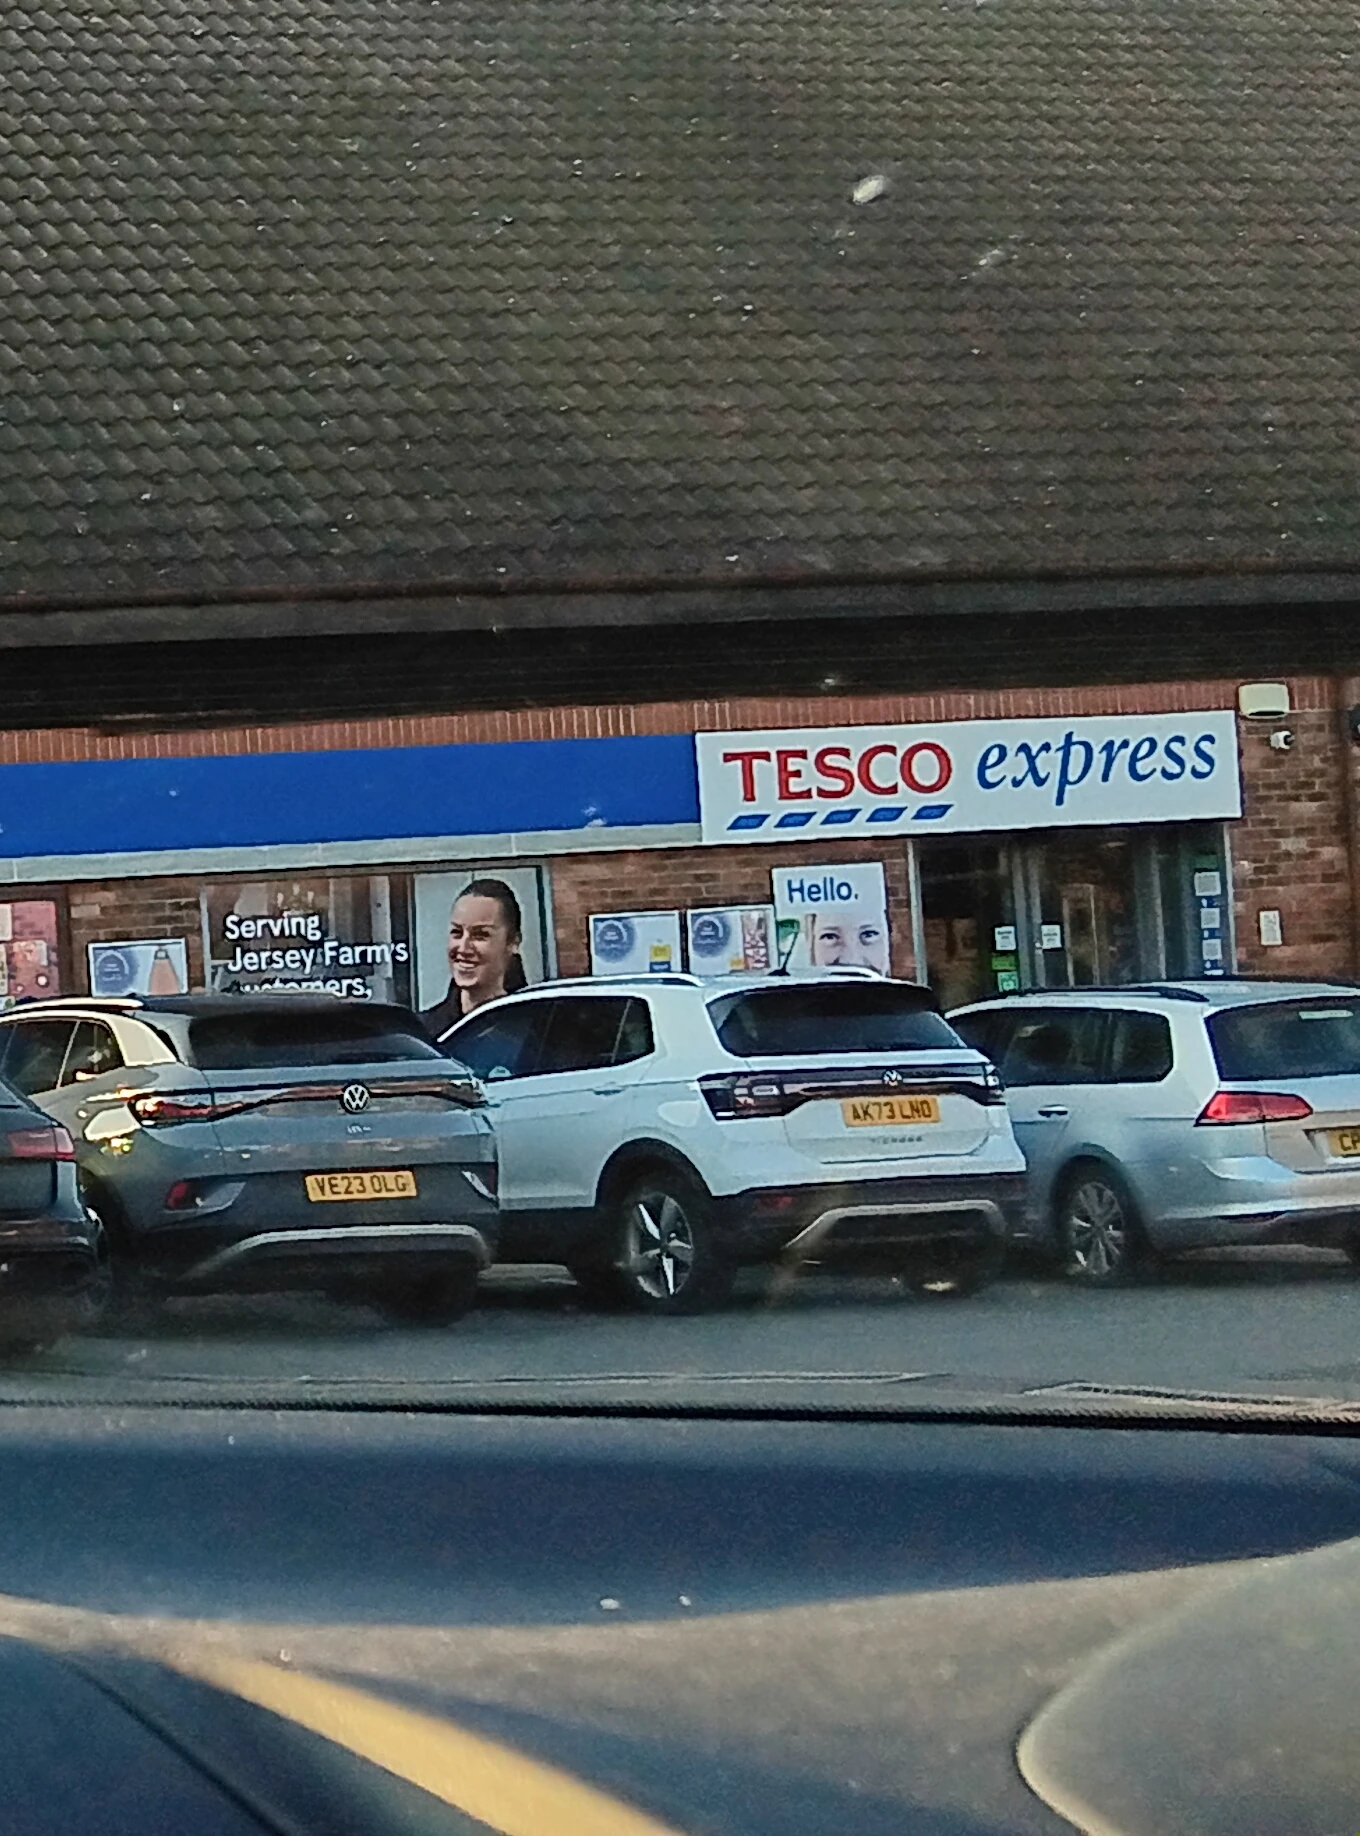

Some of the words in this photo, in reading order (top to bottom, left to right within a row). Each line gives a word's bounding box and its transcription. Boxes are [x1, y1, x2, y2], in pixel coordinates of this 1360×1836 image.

[723, 742, 952, 801] TESCO
[976, 731, 1216, 806] express
[787, 877, 858, 904] Hello.
[225, 909, 321, 941] Serving
[228, 946, 315, 974] Jersey
[323, 940, 408, 967] Farm's
[852, 1101, 896, 1121] AK73
[314, 1175, 367, 1196] VE23
